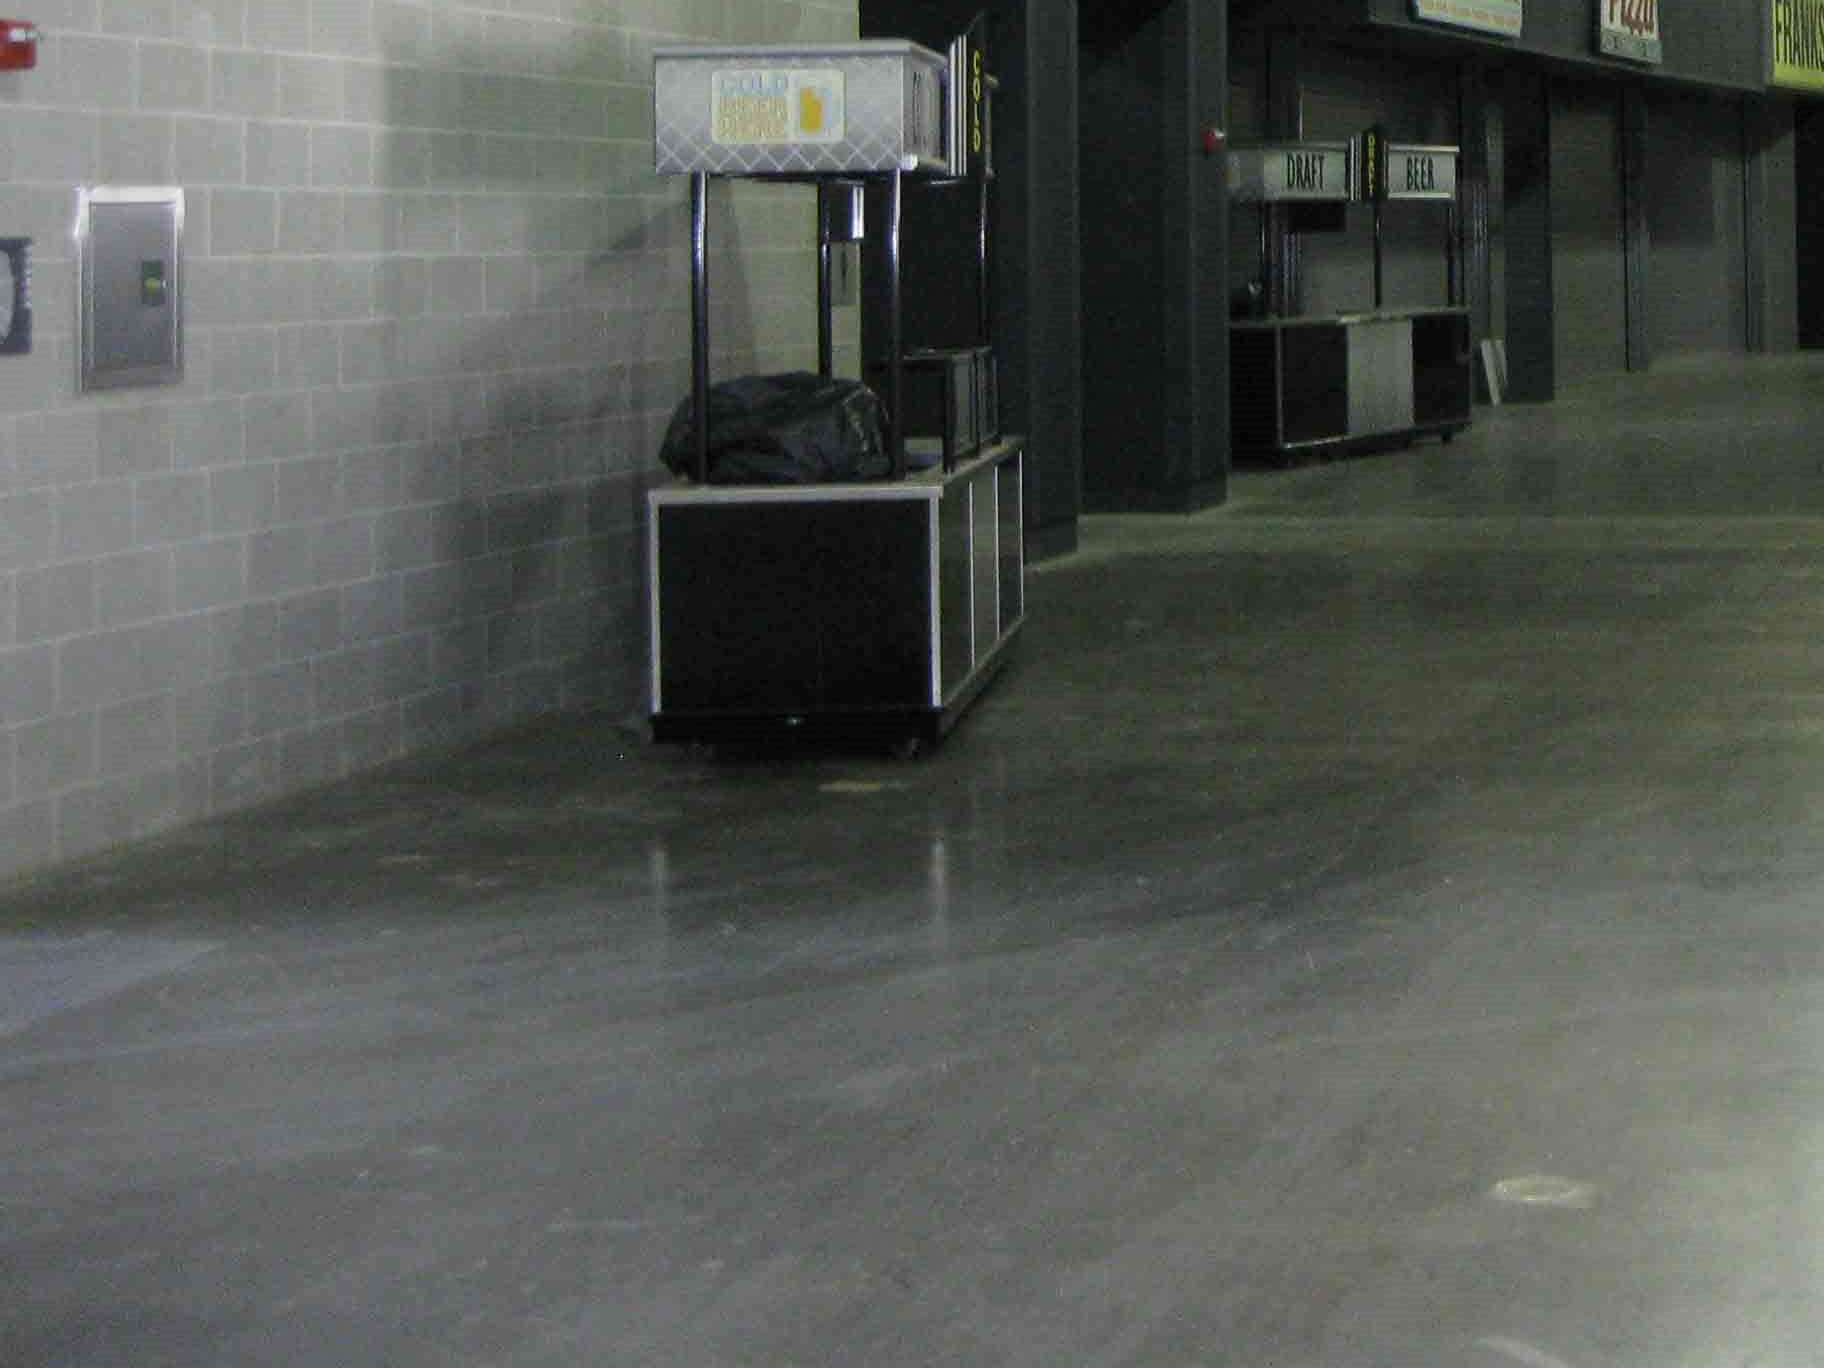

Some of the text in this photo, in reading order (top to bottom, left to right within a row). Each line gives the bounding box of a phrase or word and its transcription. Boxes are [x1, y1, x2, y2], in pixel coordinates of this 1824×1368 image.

[969, 49, 982, 154] COLD
[1286, 151, 1325, 191] DRAFT
[1406, 155, 1435, 192] BEER
